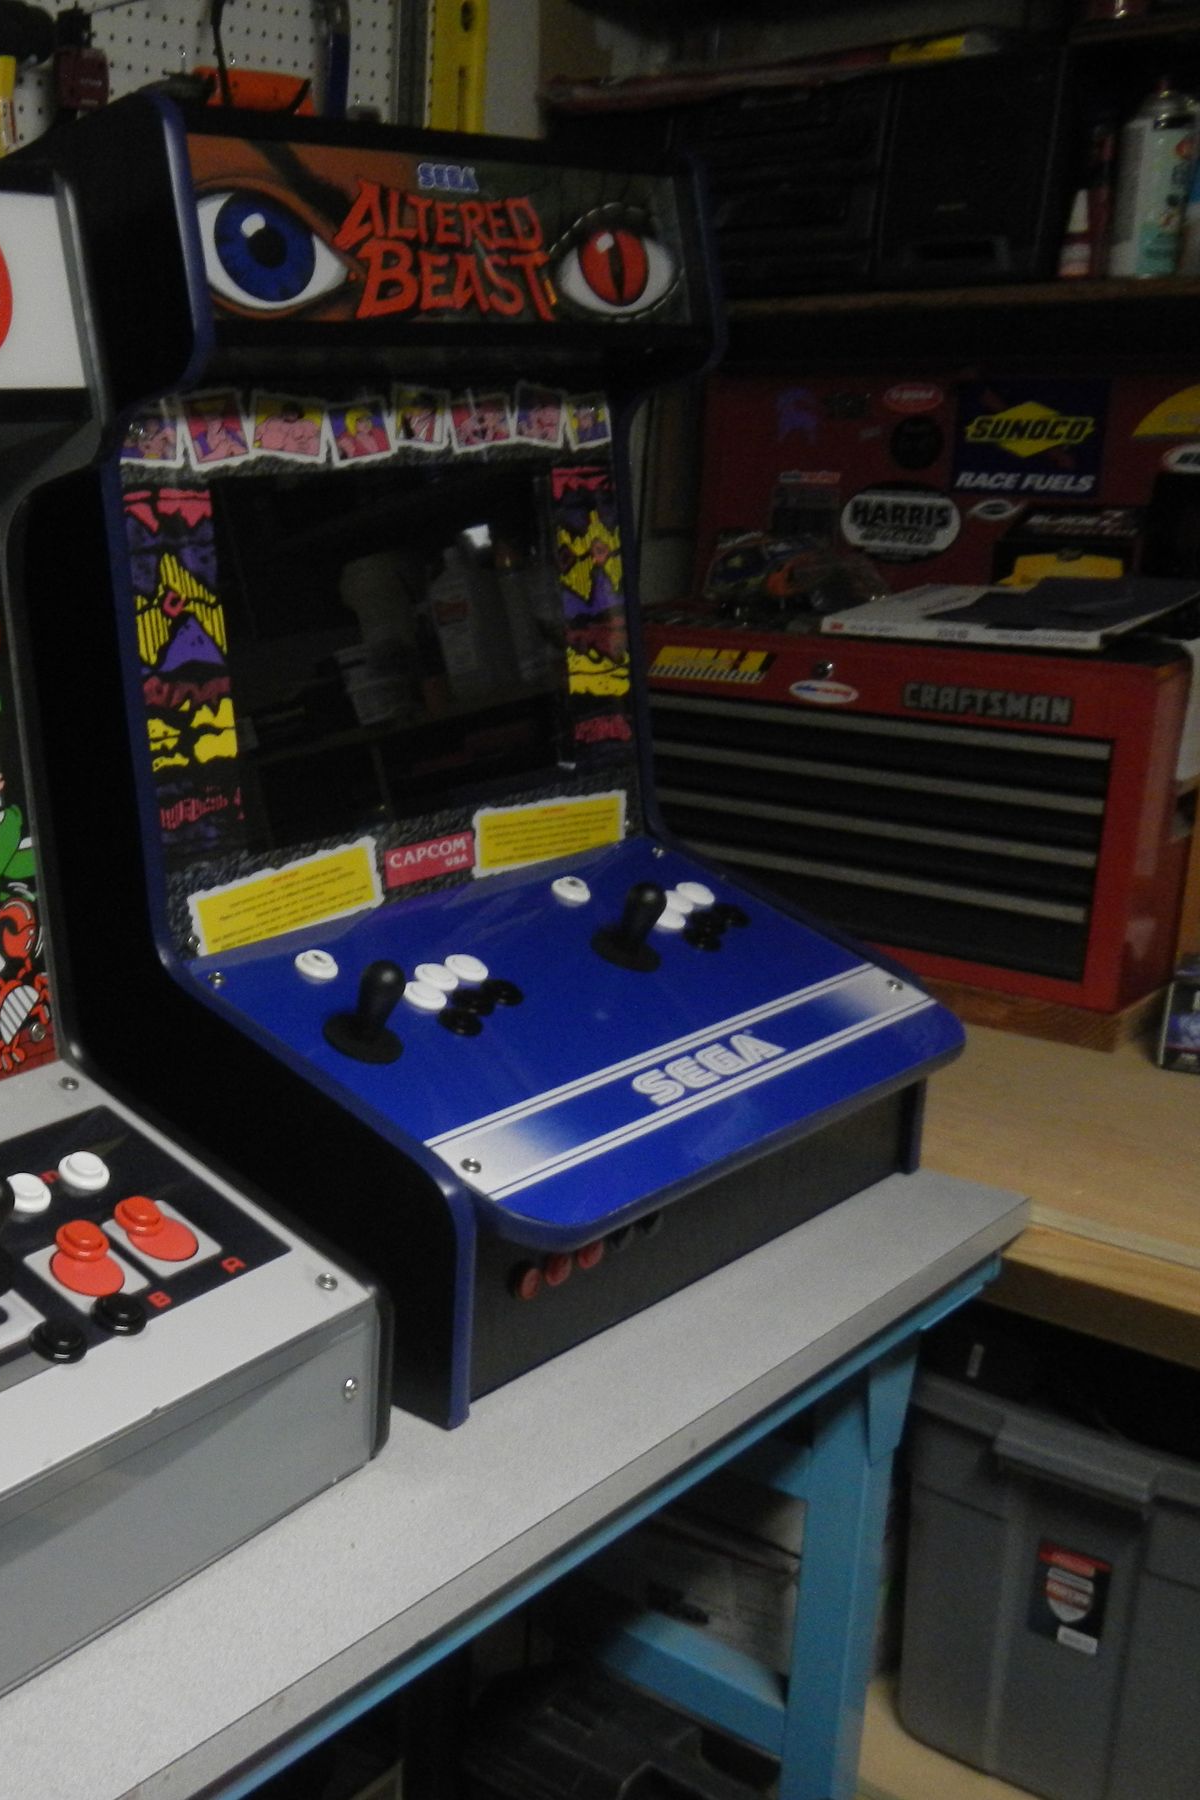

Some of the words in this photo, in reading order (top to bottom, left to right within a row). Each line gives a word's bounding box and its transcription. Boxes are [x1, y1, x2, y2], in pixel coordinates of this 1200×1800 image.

[416, 161, 480, 194] SEGA
[331, 178, 544, 251] ALTERED
[355, 238, 556, 323] BEAST
[970, 417, 1089, 441] SUNOCO
[953, 471, 1022, 490] RACE
[1019, 473, 1096, 494] FUELS
[851, 500, 952, 529] HARRIS
[905, 684, 1071, 724] CRAFTSMAN
[390, 837, 467, 868] CAPCOM
[445, 854, 468, 867] USA
[632, 1034, 787, 1107] SEGA
[147, 1291, 172, 1309] B
